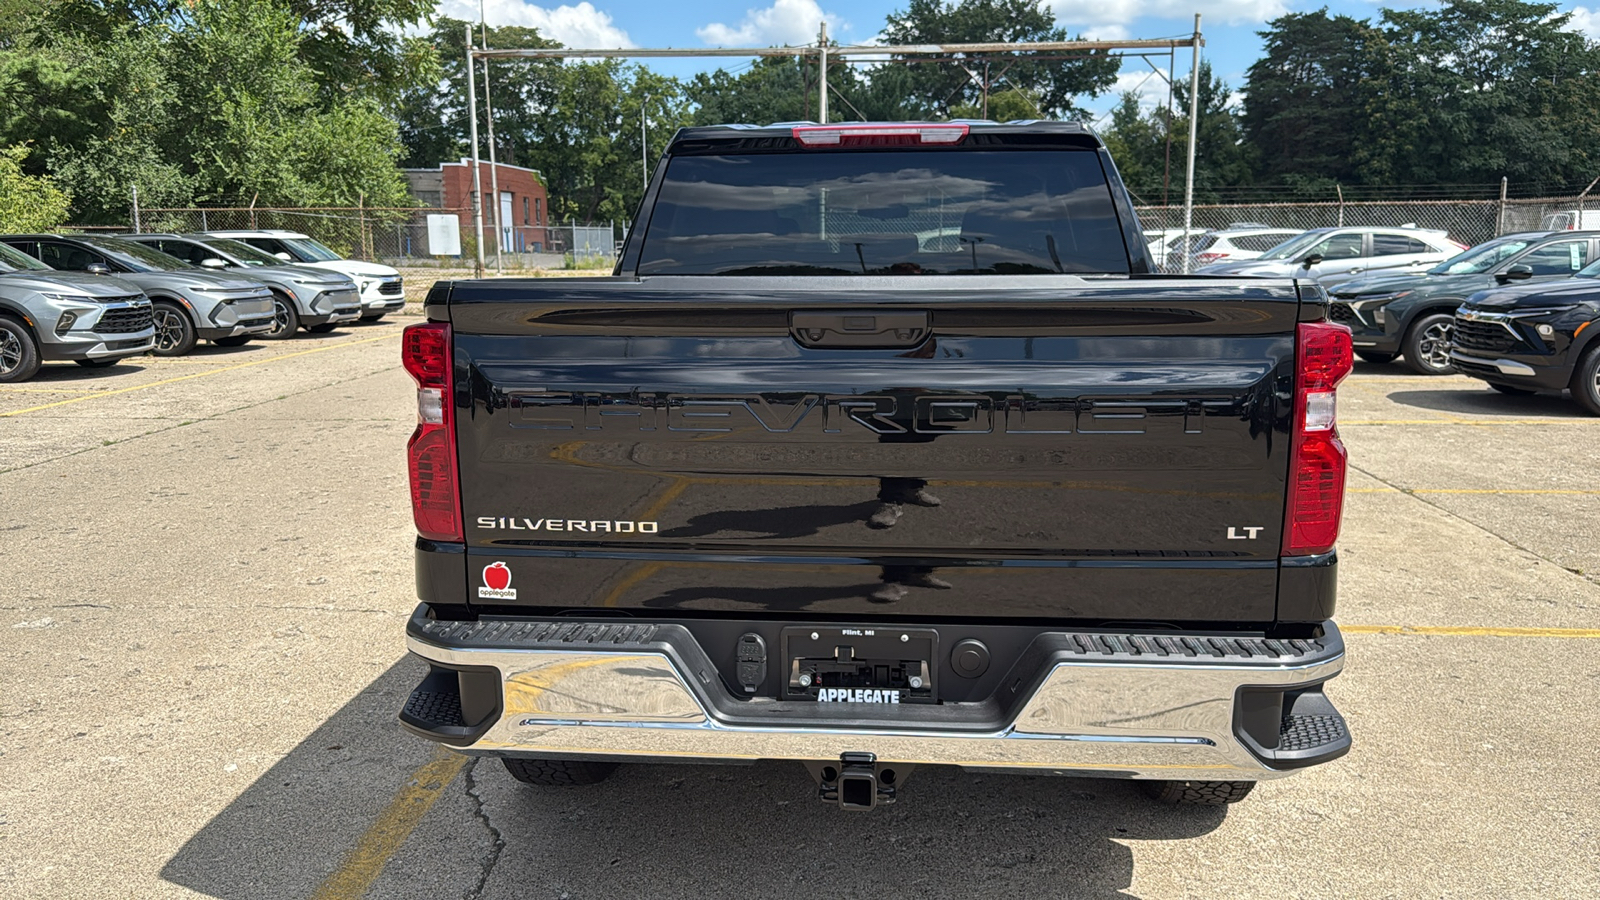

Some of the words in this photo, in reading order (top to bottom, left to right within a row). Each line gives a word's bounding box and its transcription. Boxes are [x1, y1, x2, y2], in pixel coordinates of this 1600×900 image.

[507, 391, 1234, 435] CHEVROLET
[477, 516, 658, 533] SILVERADO
[1227, 526, 1264, 539] LT
[479, 589, 516, 598] applegate
[842, 629, 863, 637] Flint,
[817, 688, 900, 704] APPLEGATE
